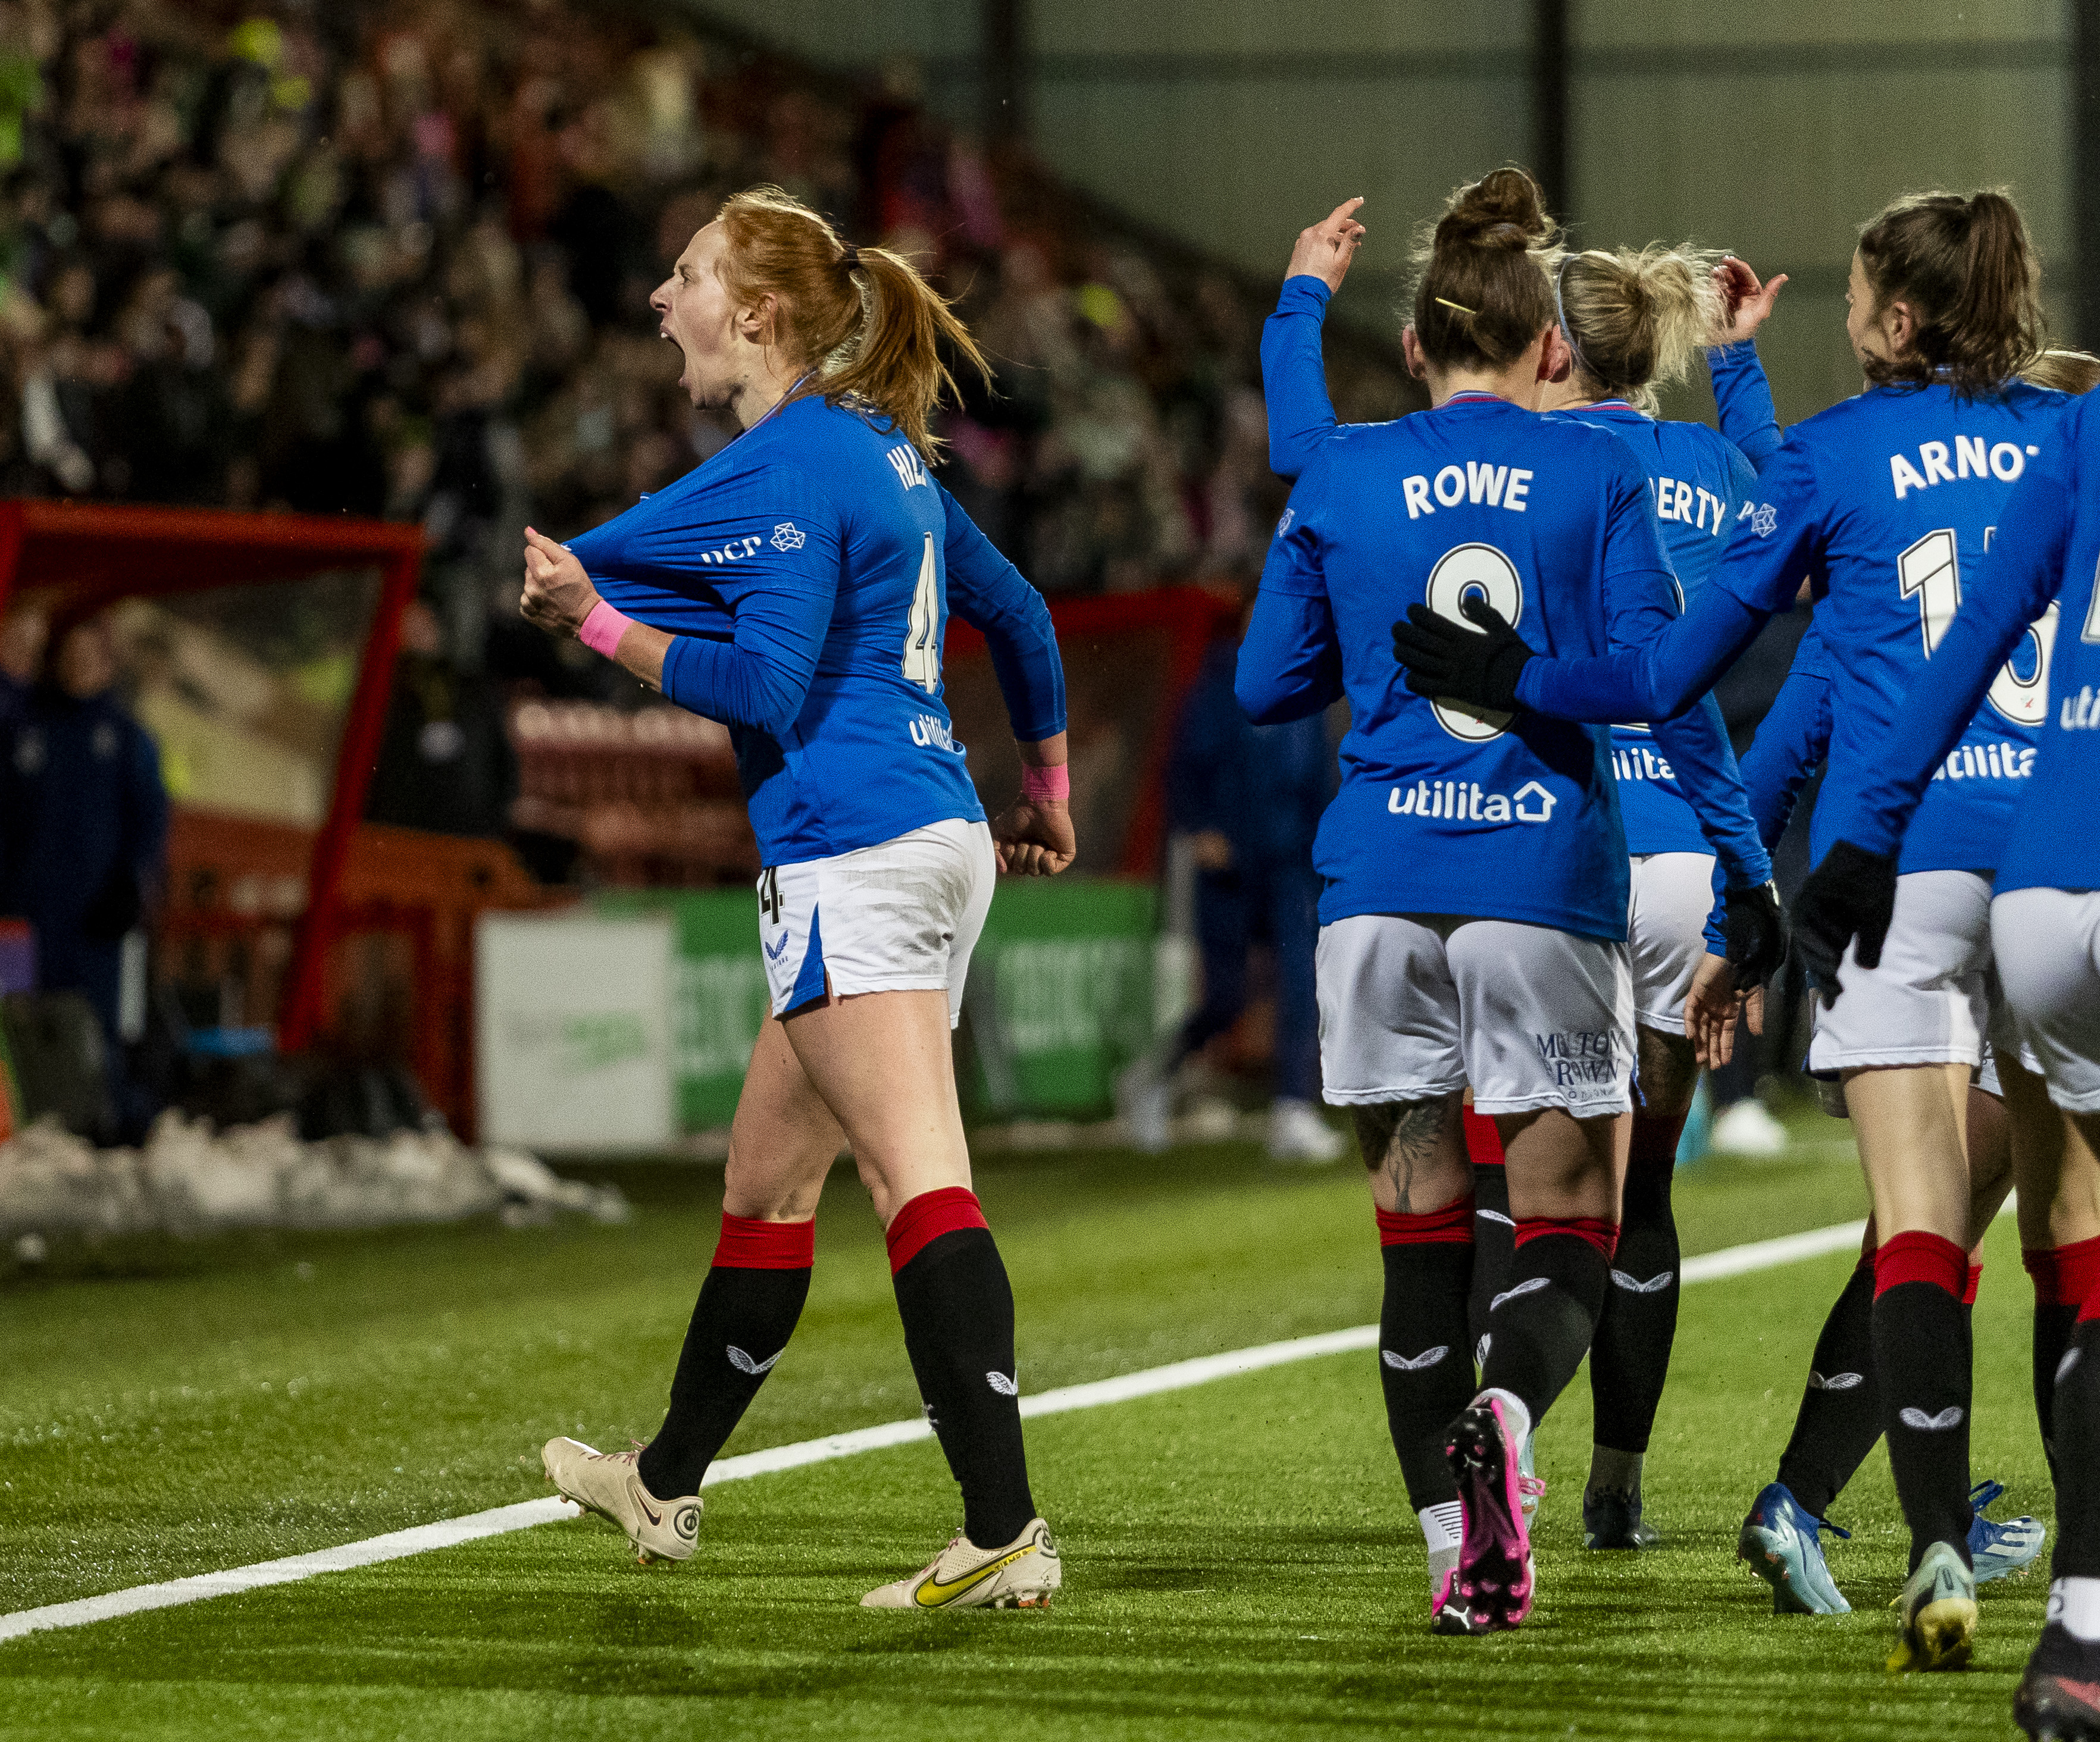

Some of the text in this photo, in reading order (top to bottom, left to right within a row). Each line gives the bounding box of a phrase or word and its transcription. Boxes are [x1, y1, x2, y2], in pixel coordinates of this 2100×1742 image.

[1403, 461, 1533, 519] ROWE
[1889, 434, 2040, 500] ARNO
[1648, 477, 1726, 536] ERTY
[902, 531, 938, 695] 4
[1387, 780, 1513, 822] utilita
[760, 866, 785, 926] 4
